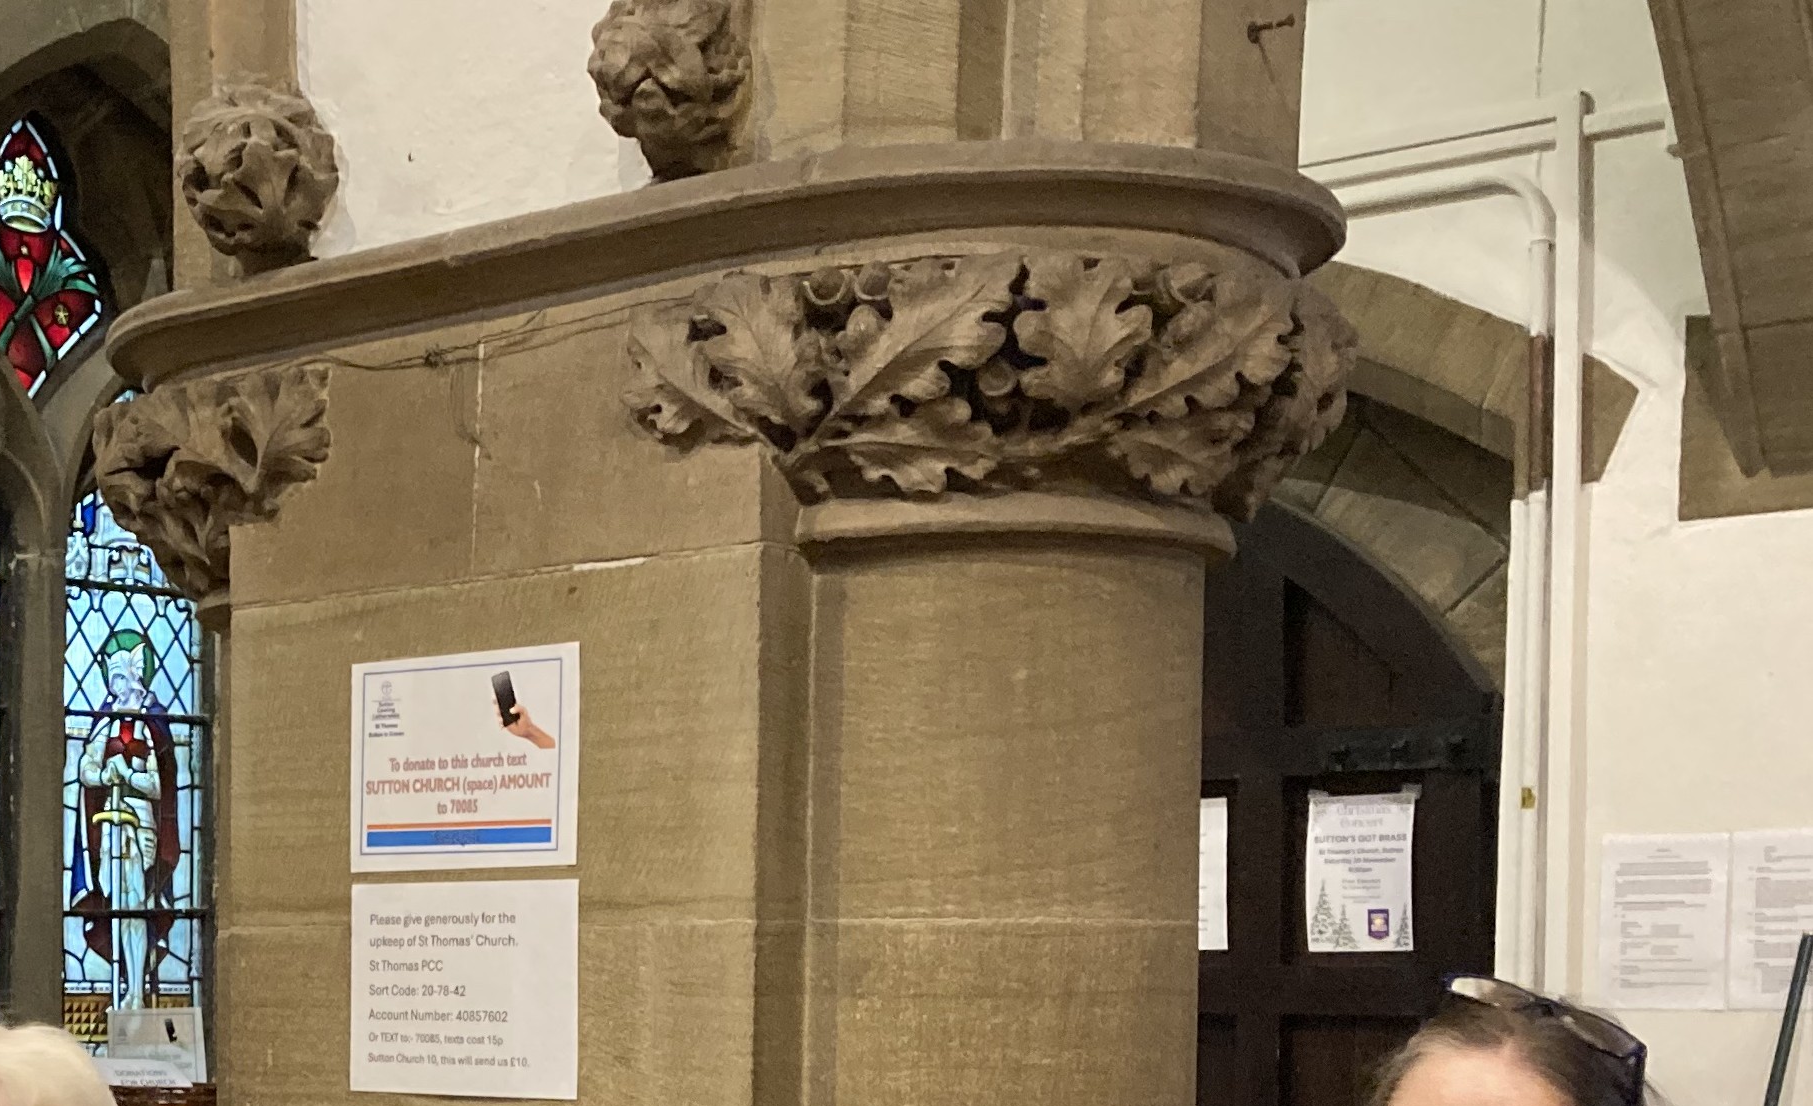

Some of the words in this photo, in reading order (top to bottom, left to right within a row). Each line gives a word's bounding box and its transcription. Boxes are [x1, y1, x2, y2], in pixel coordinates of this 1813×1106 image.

[389, 757, 401, 772] To
[403, 757, 436, 772] donate
[438, 756, 449, 770] to
[451, 754, 469, 769] this
[471, 752, 505, 768] church
[507, 753, 528, 767] text
[366, 779, 410, 796] SUTTON
[412, 777, 460, 794] CHURCH
[463, 775, 498, 795] (space)
[499, 772, 553, 790] AMOUNT
[437, 802, 448, 815] to
[1378, 833, 1407, 841] BRASS
[370, 914, 402, 926] Please
[403, 913, 423, 928] give
[424, 912, 480, 928] generously
[481, 911, 496, 924] for
[498, 912, 517, 924] the
[369, 935, 406, 950] upkeep
[406, 935, 417, 947] of
[418, 935, 429, 947] St
[475, 933, 519, 946] Church.
[369, 960, 380, 972] St
[382, 960, 420, 971] Thomas
[421, 960, 444, 971] PCC
[369, 984, 390, 996] Sort
[391, 984, 419, 996] Code:
[421, 984, 466, 997] 20-78-42
[368, 1008, 410, 1020] Account
[410, 1009, 454, 1021] Number:
[455, 1010, 509, 1022] 40857602
[368, 1032, 379, 1042] Or
[380, 1032, 399, 1043] TEXT
[444, 1034, 465, 1044] texts
[466, 1035, 485, 1044] cost
[486, 1034, 504, 1046] 15p
[367, 1052, 395, 1063] Sutton
[396, 1053, 425, 1064] Church
[440, 1055, 456, 1065] this
[457, 1056, 473, 1065] will
[474, 1056, 496, 1066] send
[497, 1058, 508, 1066] us
